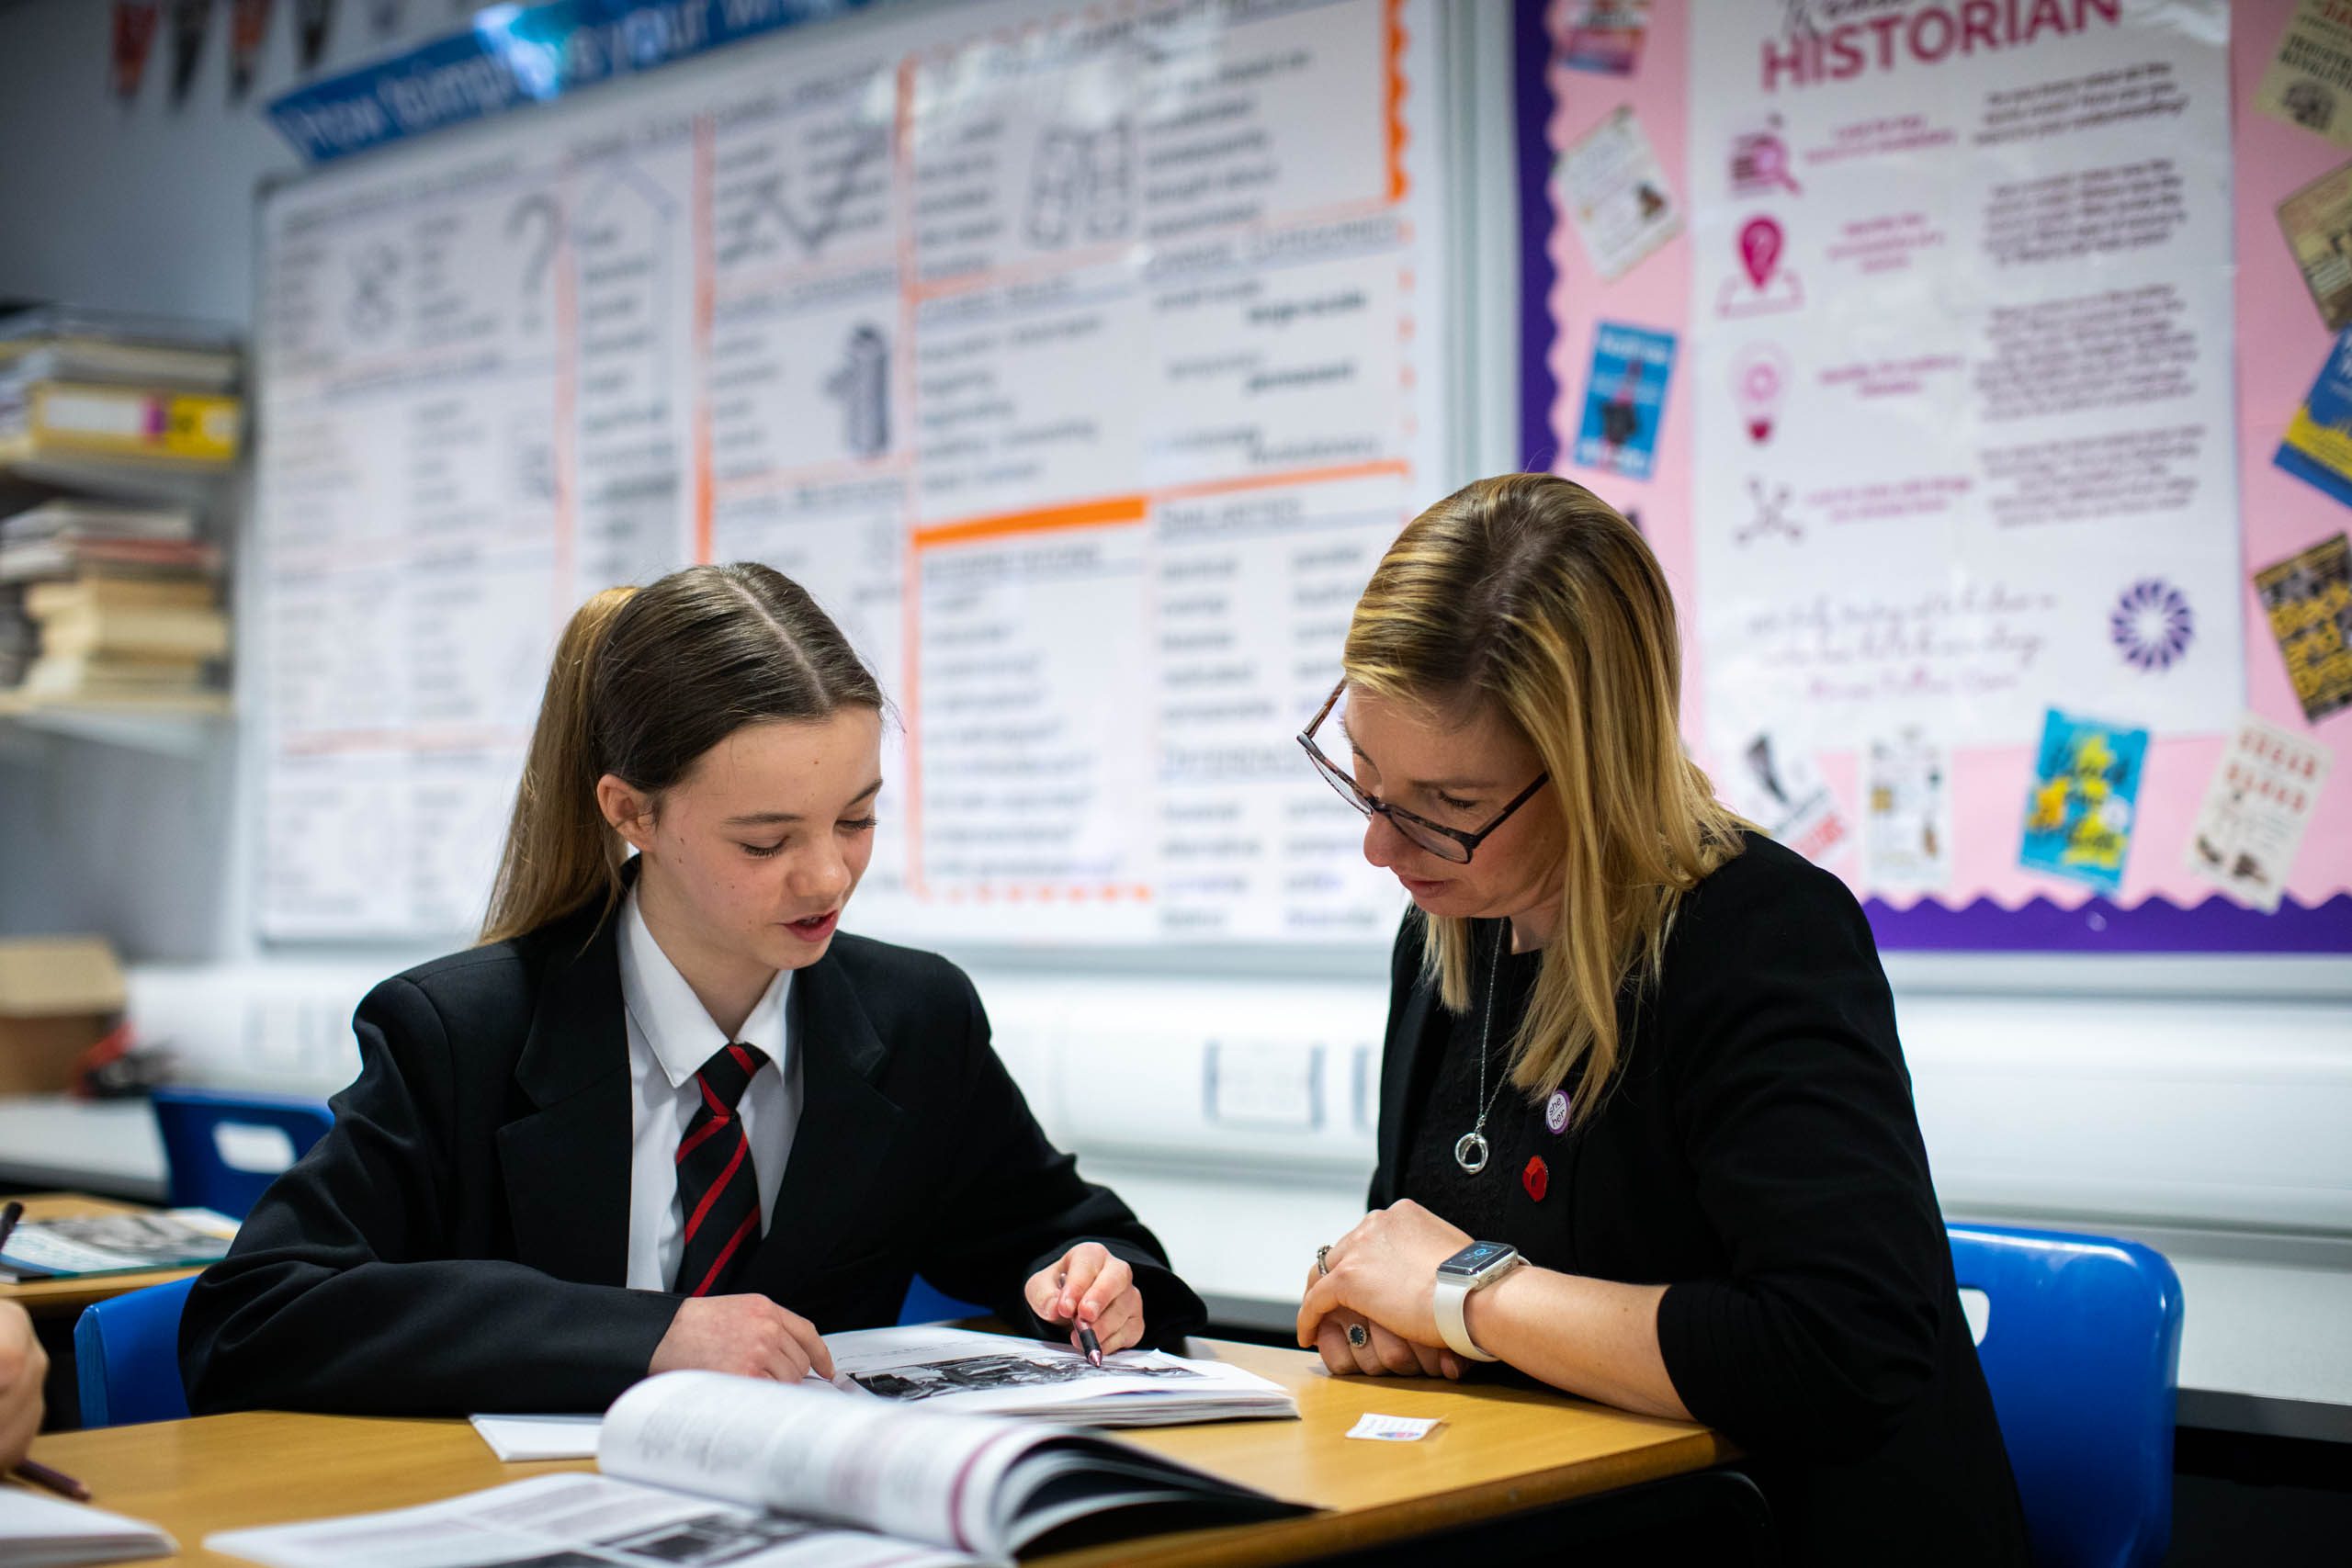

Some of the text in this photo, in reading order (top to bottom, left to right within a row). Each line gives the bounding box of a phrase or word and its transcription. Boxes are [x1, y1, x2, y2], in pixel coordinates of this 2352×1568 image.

[1761, 0, 2122, 93] HISTORIAN
[1549, 1097, 1562, 1117] she
[1552, 1109, 1565, 1128] her
